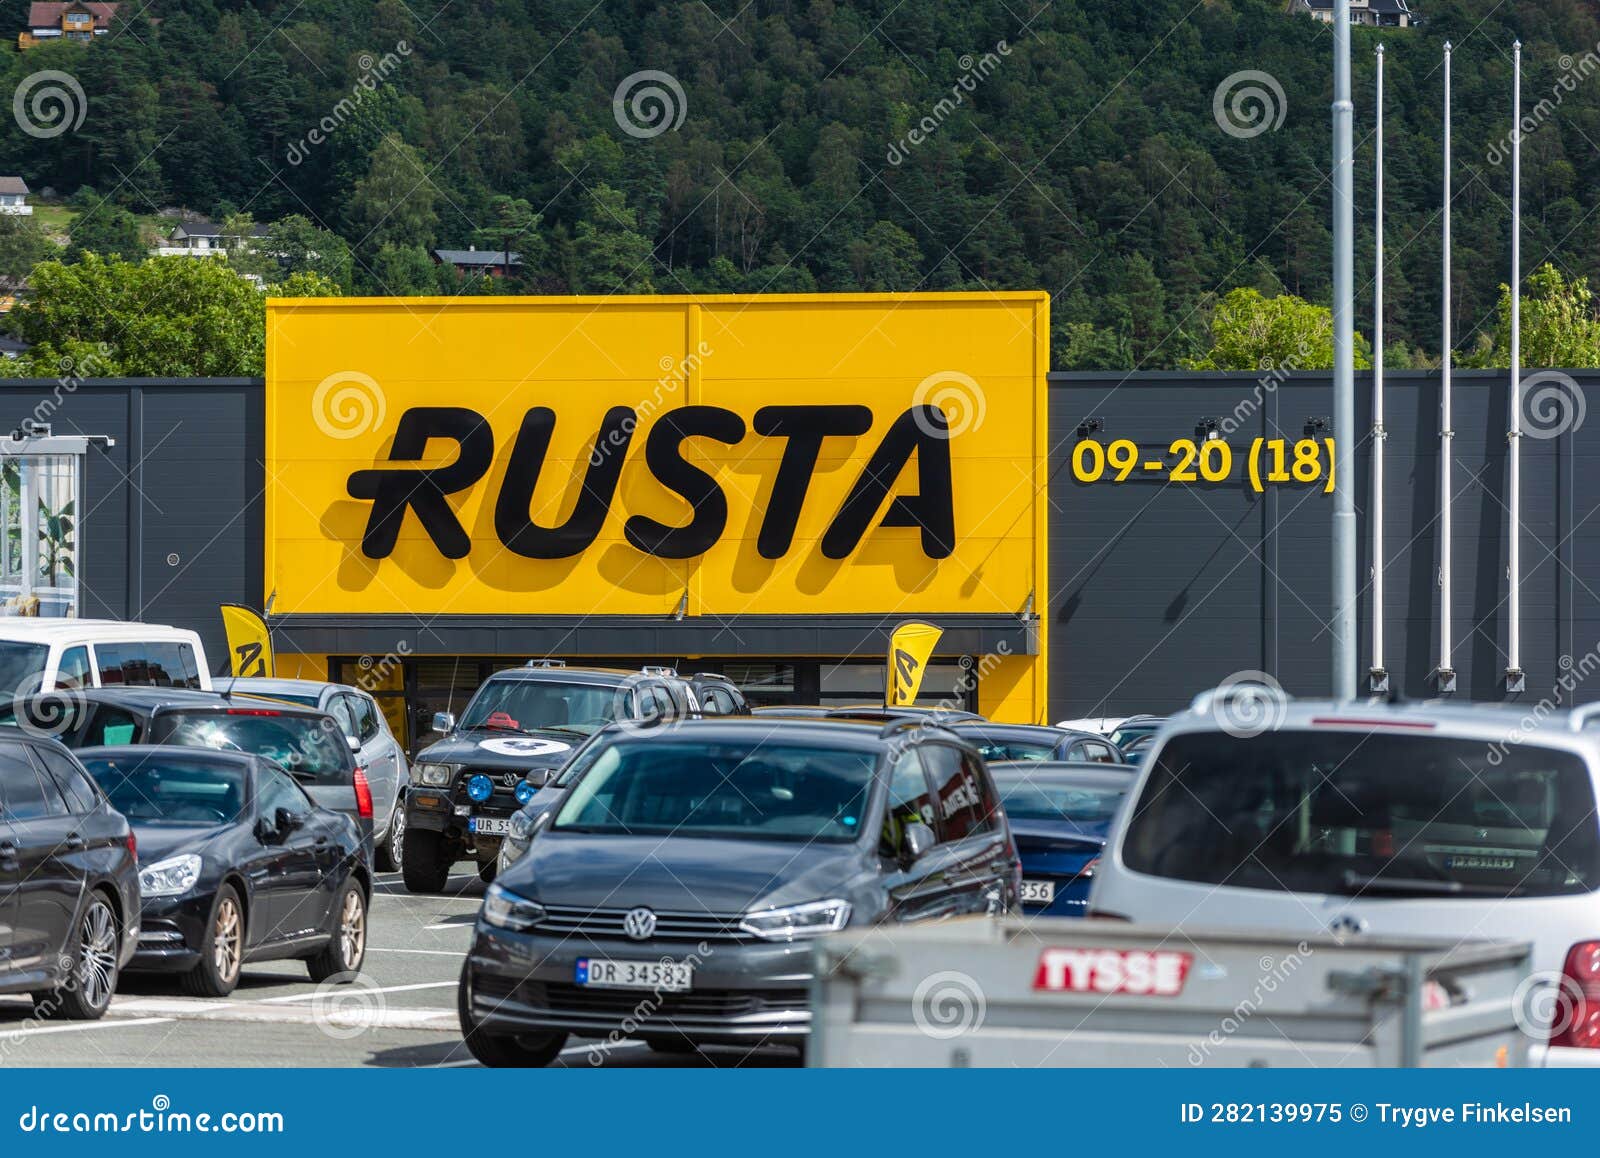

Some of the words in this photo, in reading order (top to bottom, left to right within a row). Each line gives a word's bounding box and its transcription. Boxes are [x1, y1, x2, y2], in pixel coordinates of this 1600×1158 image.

[346, 404, 956, 560] RUSTA
[591, 962, 616, 982] DR
[625, 964, 687, 985] 34582
[1043, 949, 1184, 993] TYSSE
